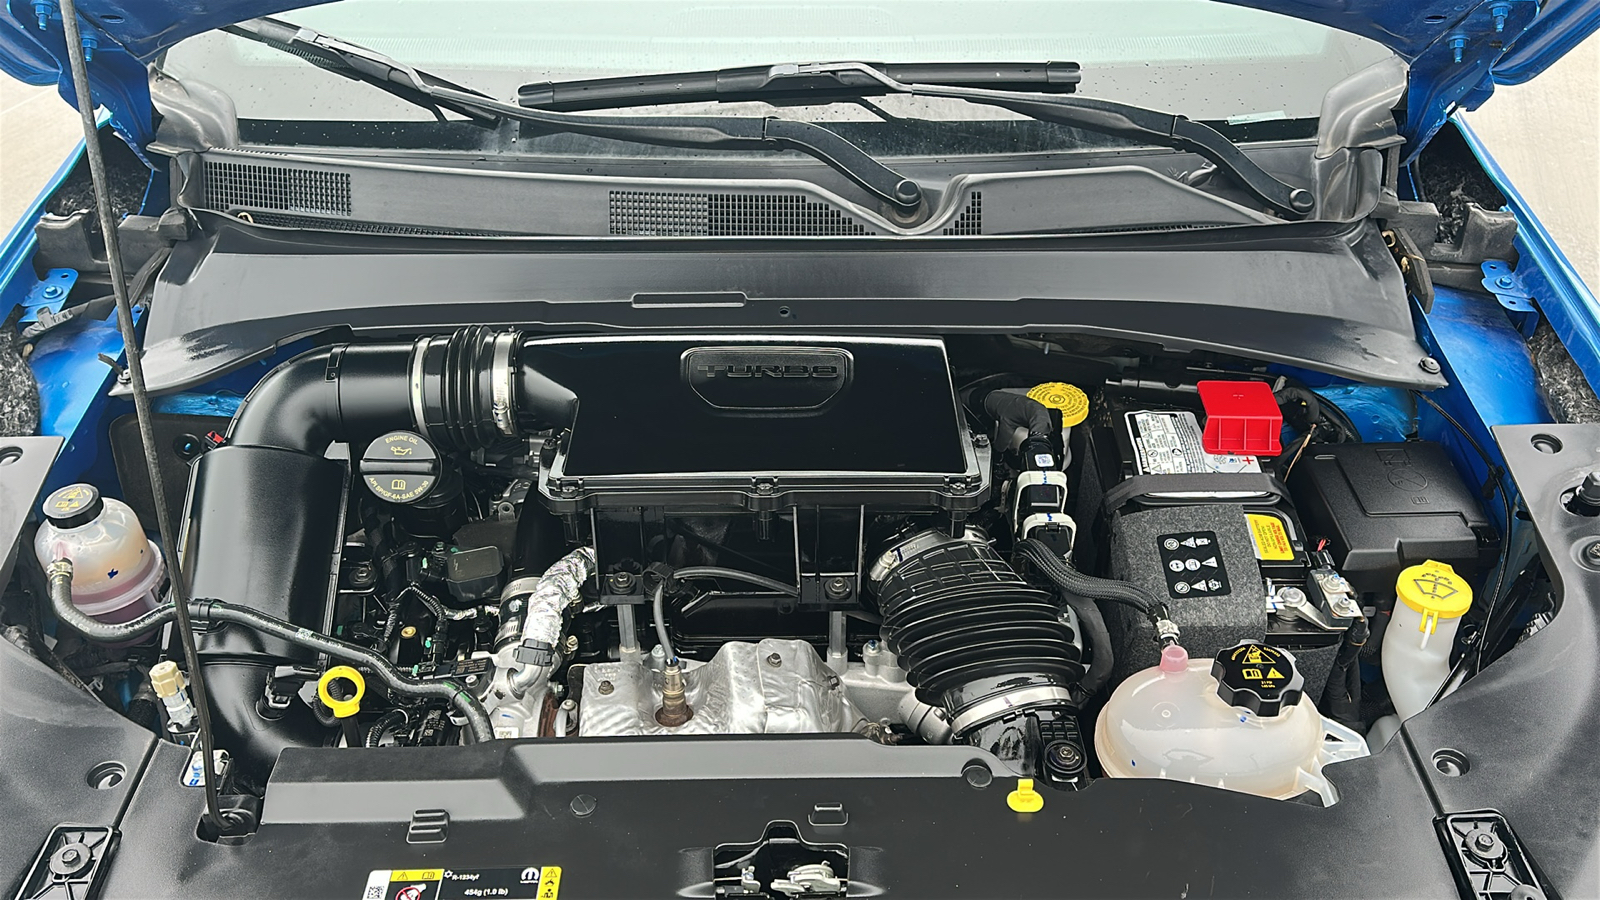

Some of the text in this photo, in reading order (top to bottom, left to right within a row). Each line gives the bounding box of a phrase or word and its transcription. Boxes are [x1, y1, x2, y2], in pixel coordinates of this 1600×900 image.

[697, 364, 838, 378] TURBO
[385, 435, 418, 445] ENGINE OIL
[368, 477, 378, 488] API
